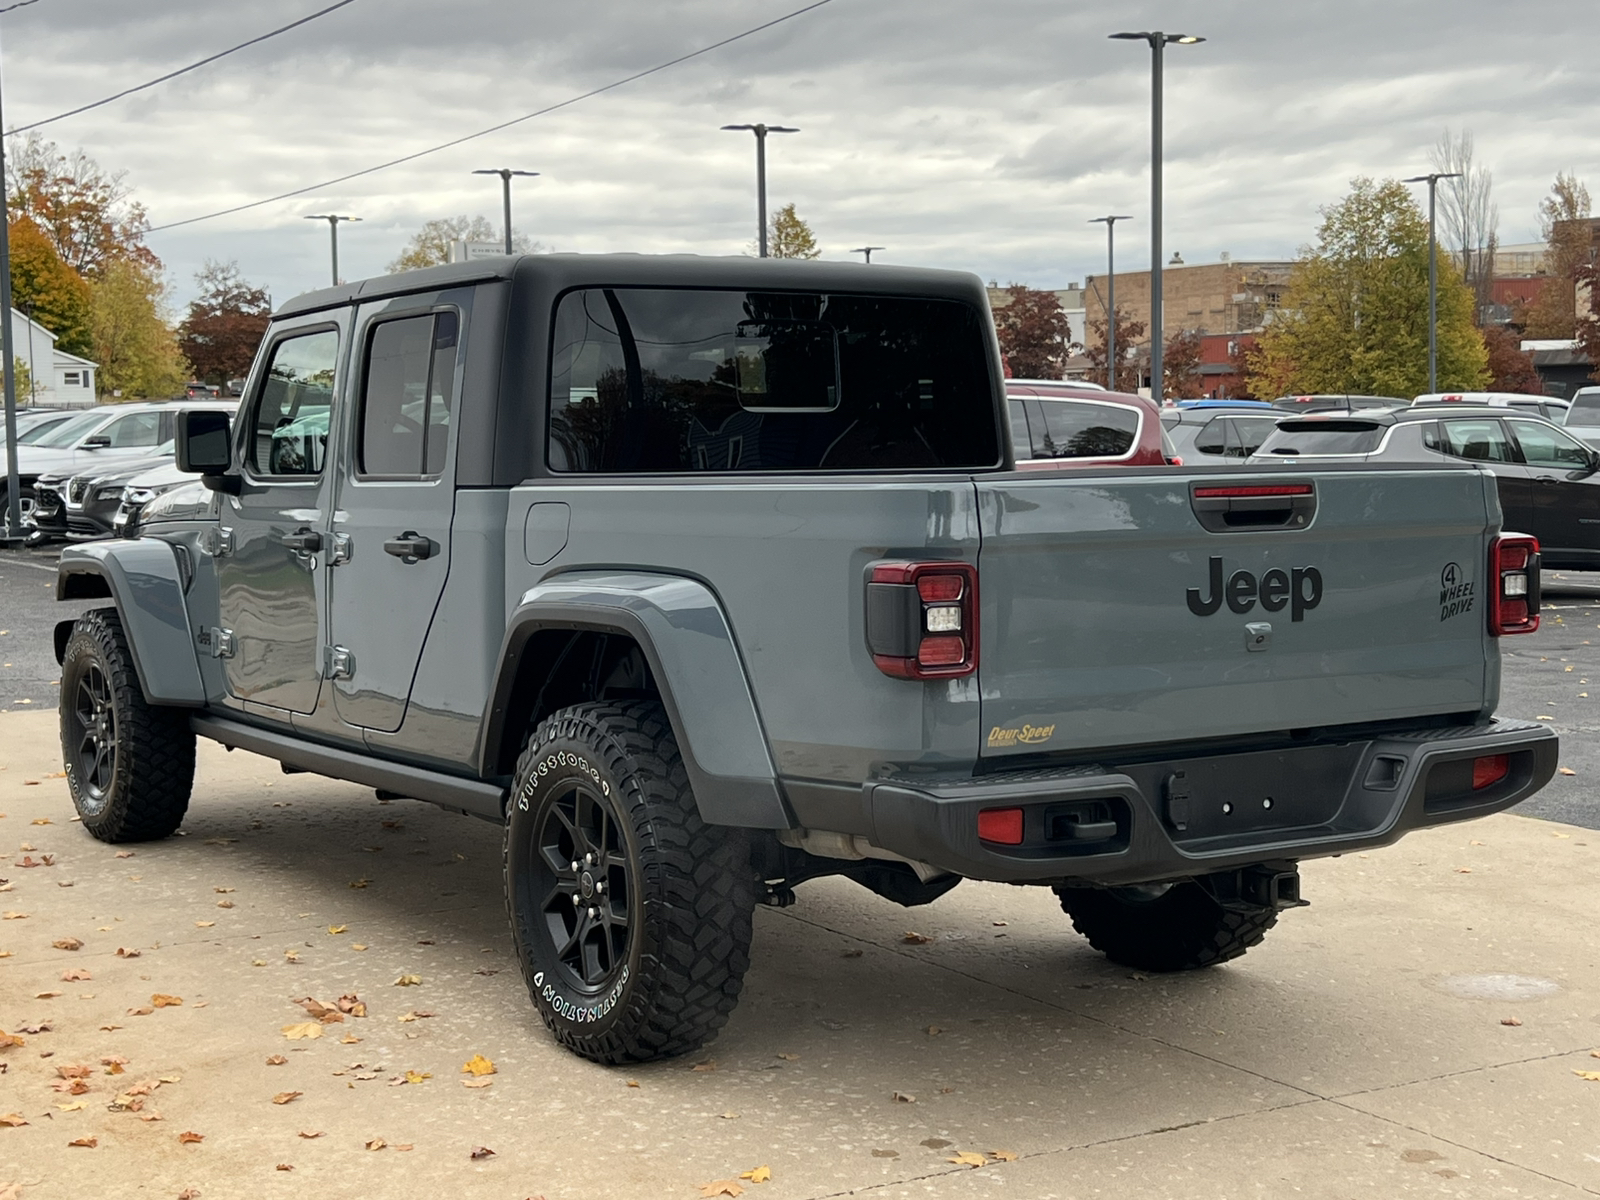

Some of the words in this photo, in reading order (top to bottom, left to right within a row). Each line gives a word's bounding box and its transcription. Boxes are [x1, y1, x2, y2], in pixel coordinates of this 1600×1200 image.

[1186, 556, 1323, 622] Jeep
[1440, 581, 1475, 606] WHEEL
[1444, 565, 1456, 585] 4
[1440, 597, 1475, 622] DRIVE
[518, 751, 600, 812] Firestone
[542, 964, 630, 1023] DESTINATION
